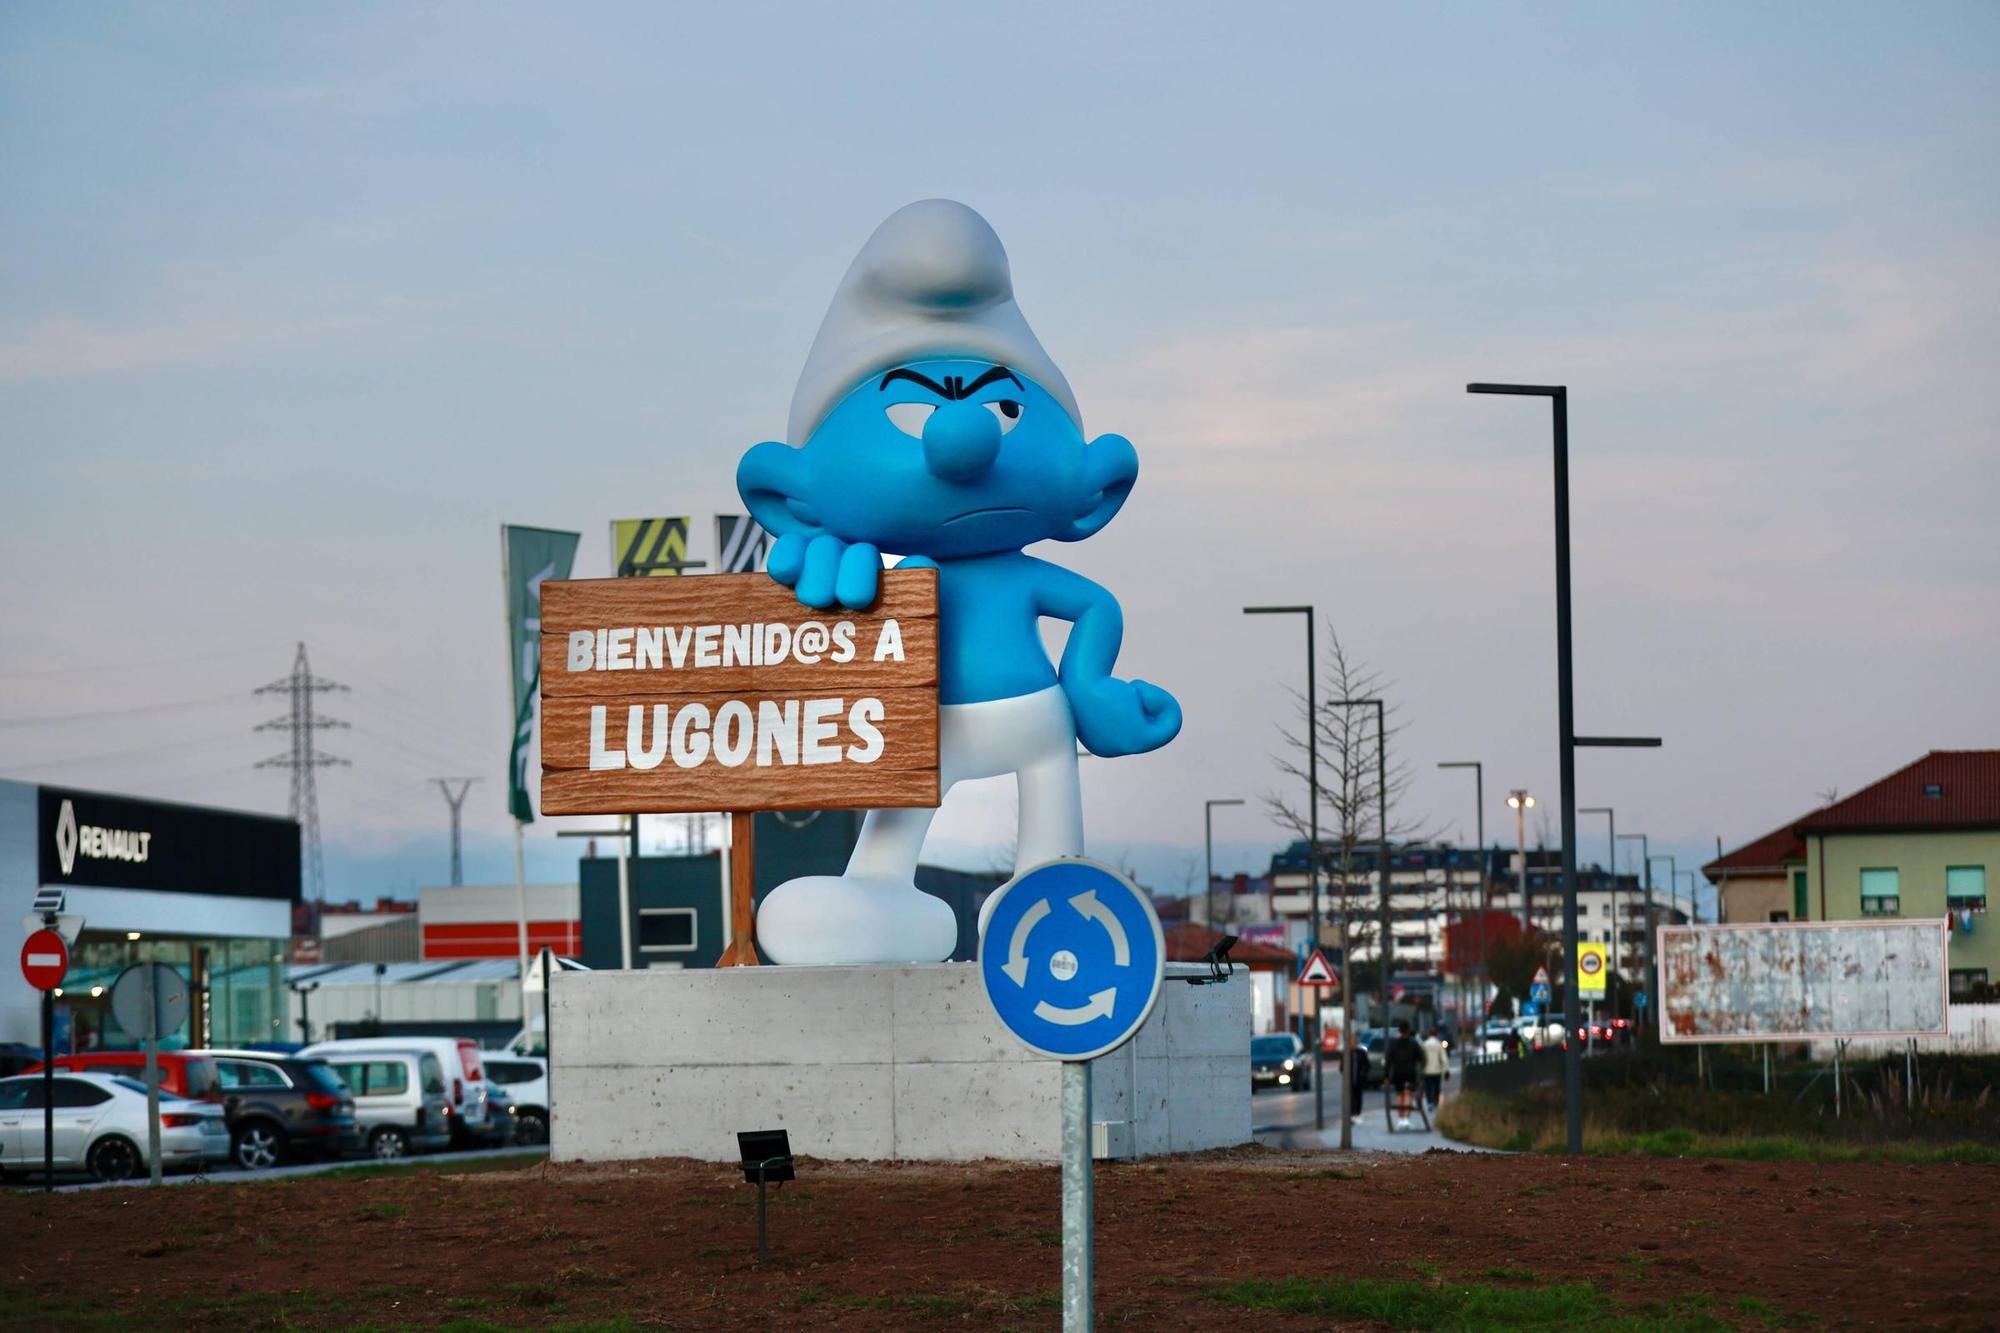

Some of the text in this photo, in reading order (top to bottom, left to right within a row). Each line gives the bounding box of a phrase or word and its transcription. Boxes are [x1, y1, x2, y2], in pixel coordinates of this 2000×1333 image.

[567, 619, 905, 672] BIENVENID@S A
[589, 697, 886, 770] LUGONES
[80, 825, 151, 862] RENAULT
